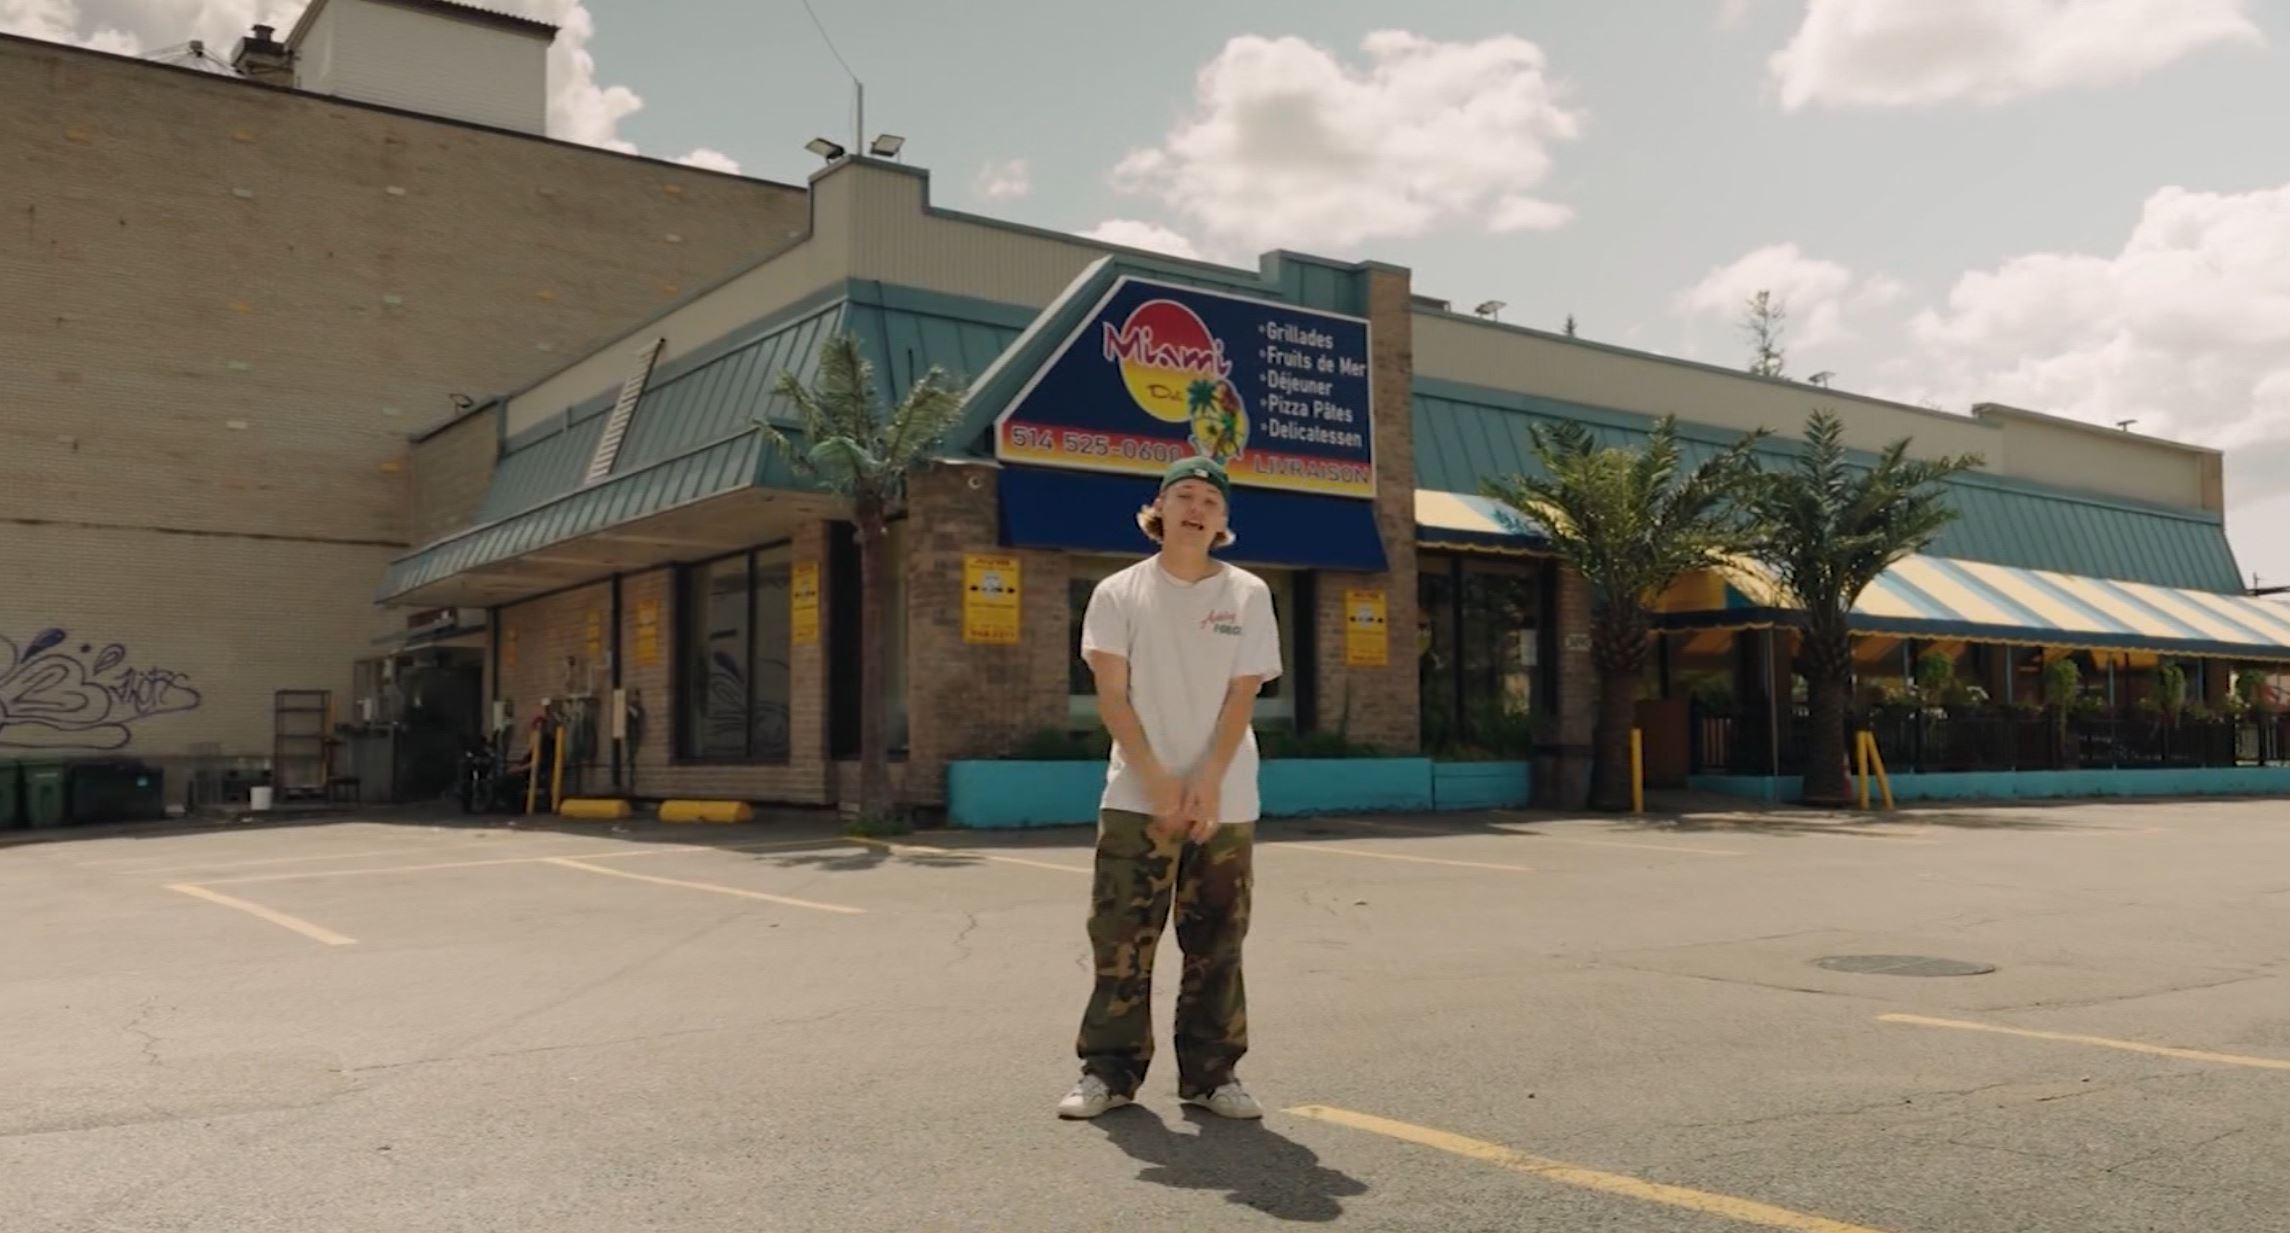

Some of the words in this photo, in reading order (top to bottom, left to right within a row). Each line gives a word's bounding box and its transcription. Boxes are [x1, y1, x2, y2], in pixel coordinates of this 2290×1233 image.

[1103, 322, 1232, 378] Miami
[1266, 321, 1334, 350] Grillades
[1267, 345, 1313, 370] Fruits
[1317, 353, 1335, 373] de
[1339, 356, 1367, 377] Mer
[1267, 369, 1334, 396] Déjeuner
[1268, 393, 1309, 417] Pizza
[1313, 399, 1354, 423] Pâtes
[1011, 424, 1054, 450] 514
[1269, 418, 1363, 448] Delicatessen
[1254, 453, 1370, 484] LIVRAISON
